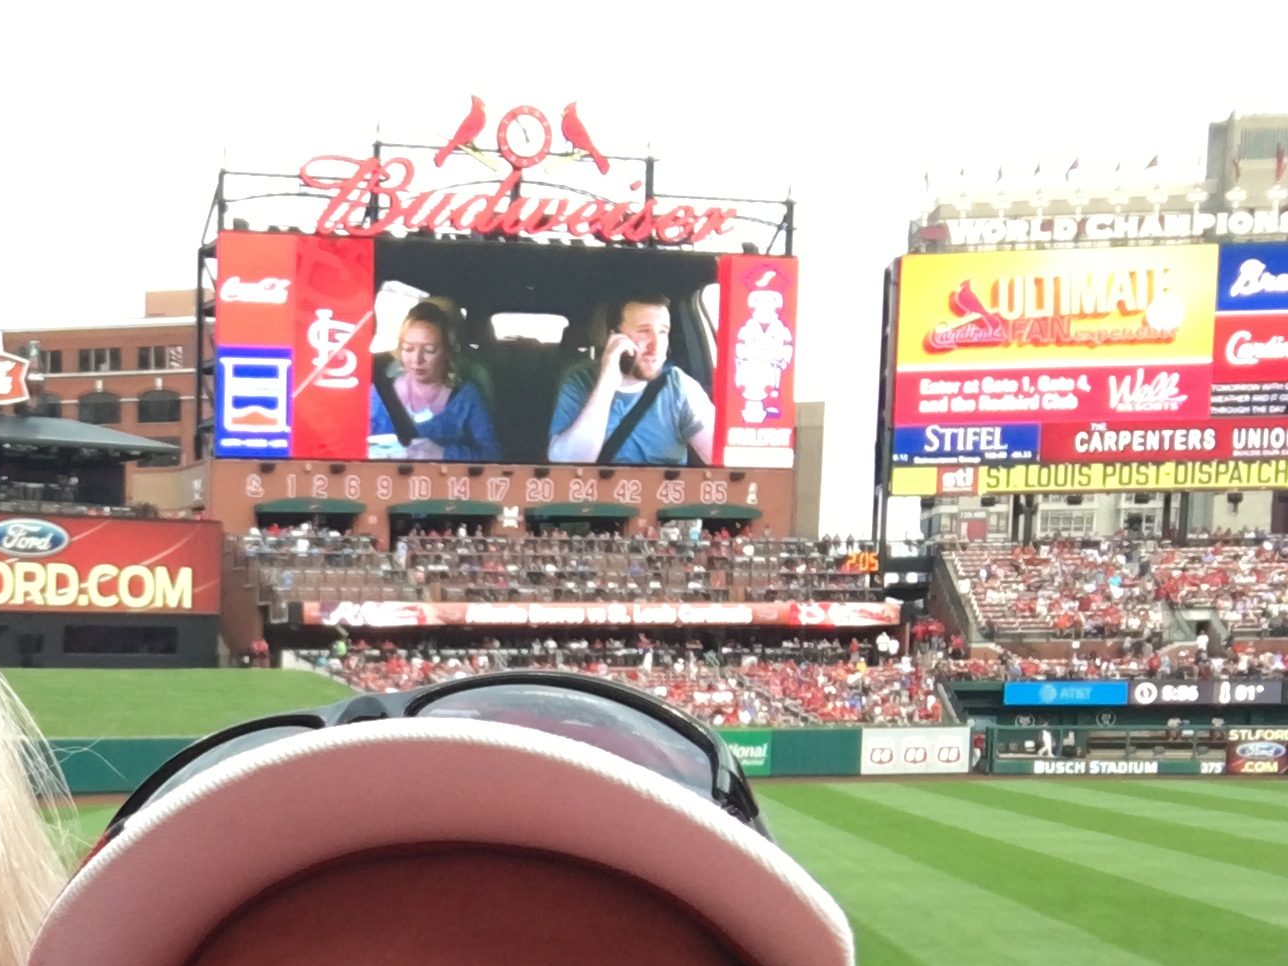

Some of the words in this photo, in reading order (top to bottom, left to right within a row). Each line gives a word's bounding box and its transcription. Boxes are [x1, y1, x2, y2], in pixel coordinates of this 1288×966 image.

[299, 154, 737, 246] Budweiser
[946, 217, 1079, 245] WORLD
[1013, 317, 1071, 343] FAN
[924, 424, 1008, 452] STIFEL
[1074, 428, 1216, 453] CARPENTERS
[1232, 427, 1288, 450] UNIO
[312, 474, 328, 499] 2
[345, 474, 360, 499] 6
[376, 475, 392, 500] 9
[409, 476, 431, 500] 10
[448, 476, 470, 500] 14
[487, 477, 510, 501] 17
[526, 478, 554, 502] 20
[569, 479, 598, 503] 24
[613, 479, 642, 503] 42
[656, 480, 685, 504] 45
[700, 481, 727, 504] 85
[1025, 463, 1091, 488] LOUIS
[1, 521, 52, 551] Ford
[1228, 729, 1288, 741] STLFOR
[1033, 760, 1086, 774] BUSCH
[1089, 760, 1158, 774] STADIUM
